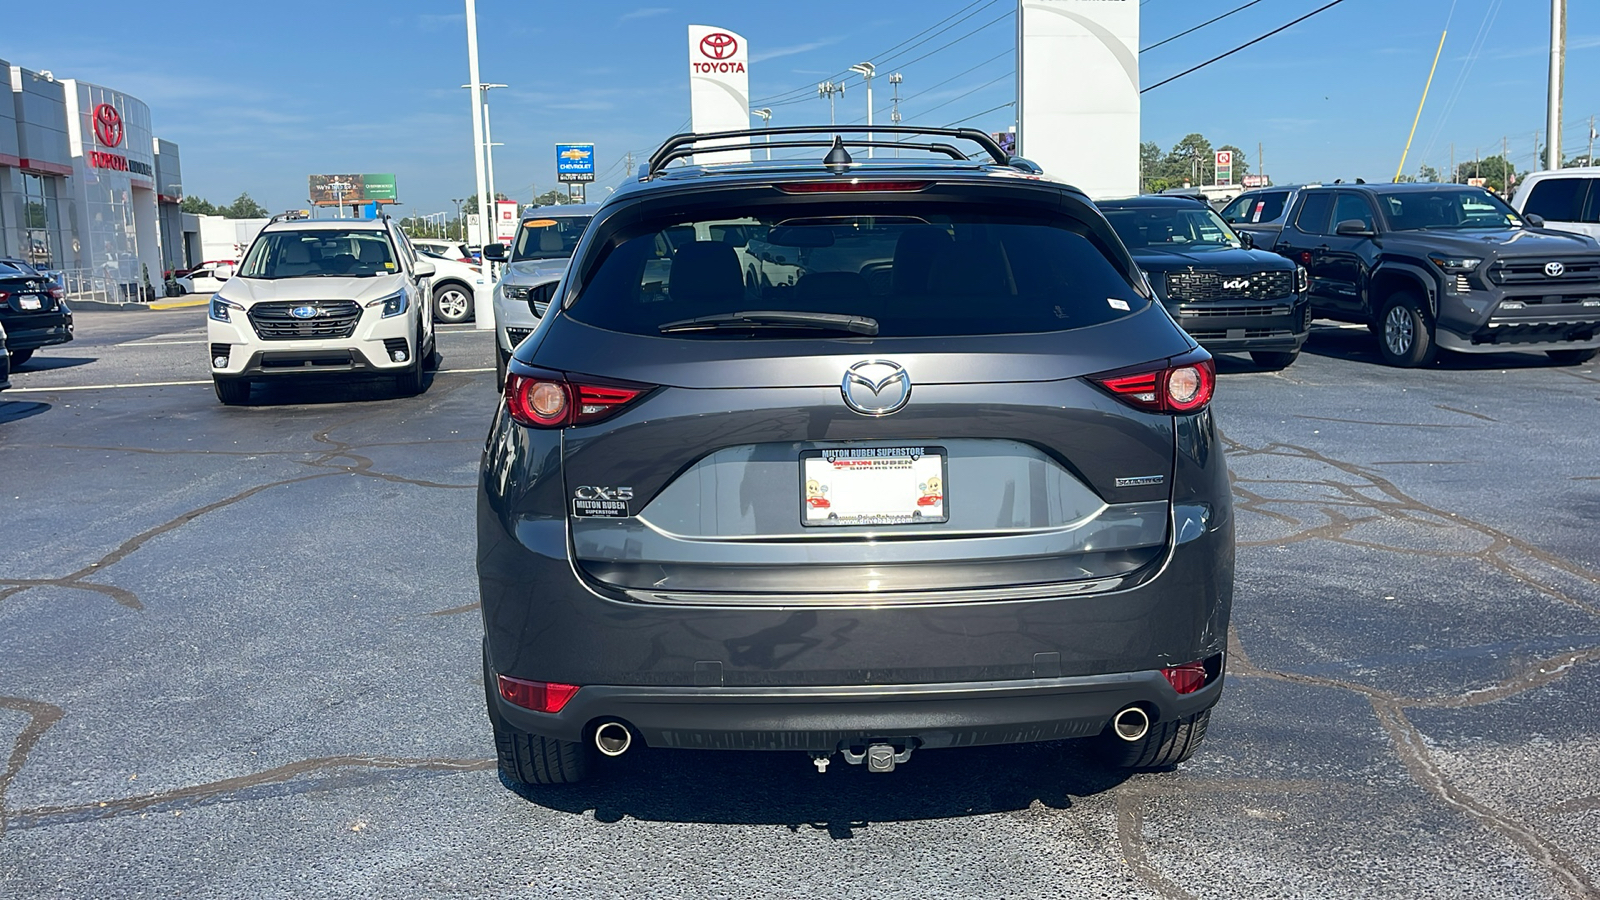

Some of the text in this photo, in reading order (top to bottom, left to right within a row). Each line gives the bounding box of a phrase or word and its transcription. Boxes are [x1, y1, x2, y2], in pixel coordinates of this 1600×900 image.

[693, 62, 745, 73] TOYOTA
[89, 151, 128, 171] TOYOTA
[822, 447, 925, 458] MILTON RUBEN SUPERSTORE
[574, 485, 633, 500] CX-5
[576, 501, 625, 509] MILTON RUBEN
